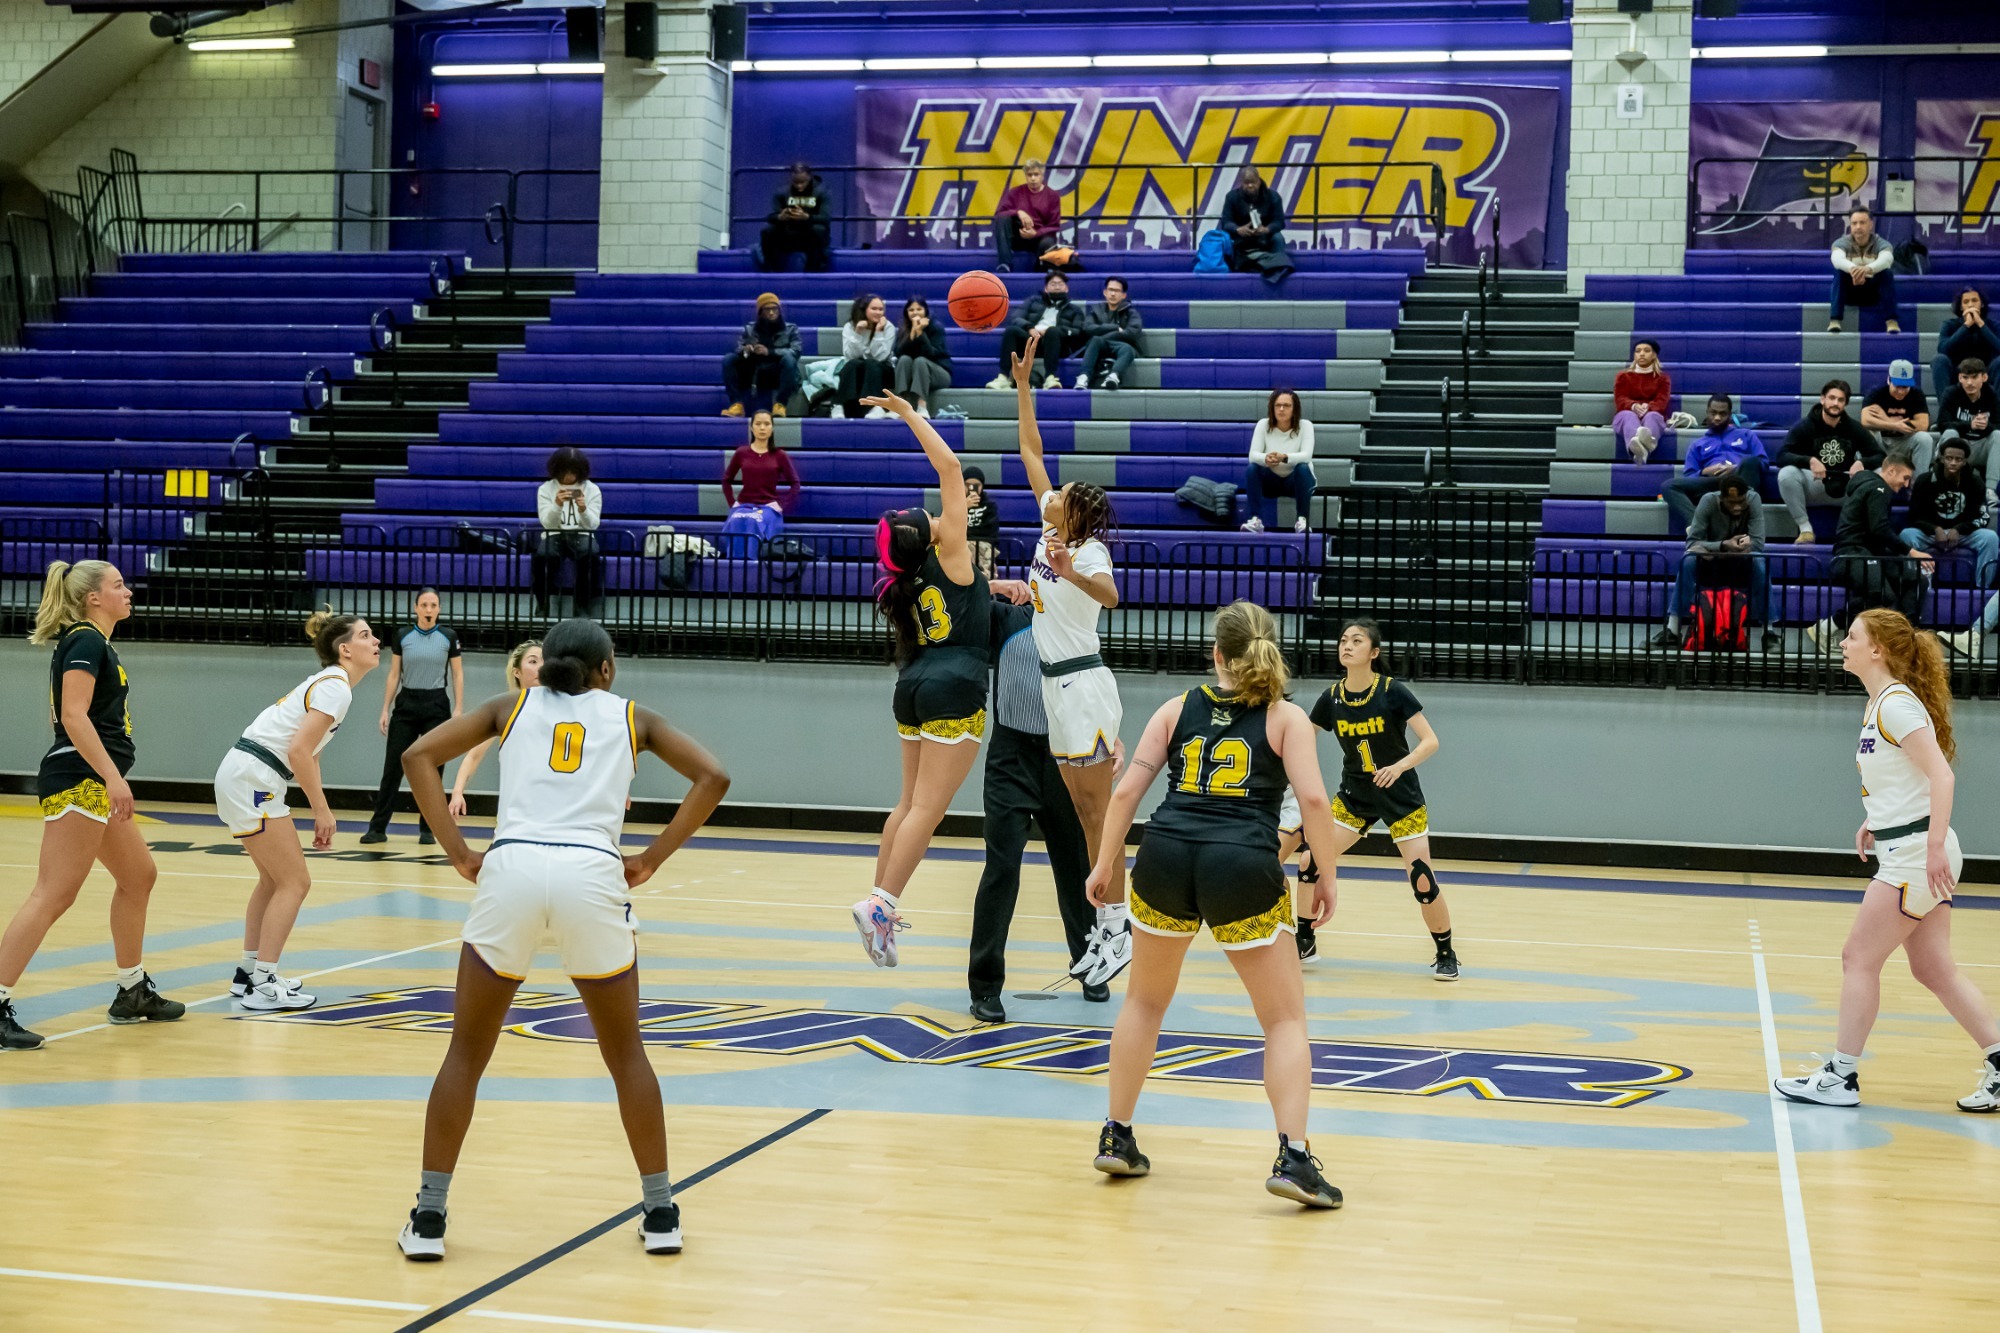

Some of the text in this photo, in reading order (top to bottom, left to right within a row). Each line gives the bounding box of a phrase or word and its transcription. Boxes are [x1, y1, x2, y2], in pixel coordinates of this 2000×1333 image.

[884, 93, 1511, 238] HUNTER
[1031, 556, 1061, 584] UNTER
[548, 721, 587, 774] 0
[1337, 716, 1385, 737] Pratt
[1176, 735, 1252, 797] 12
[1356, 739, 1378, 773] 1
[224, 985, 1692, 1109] HUNTER
